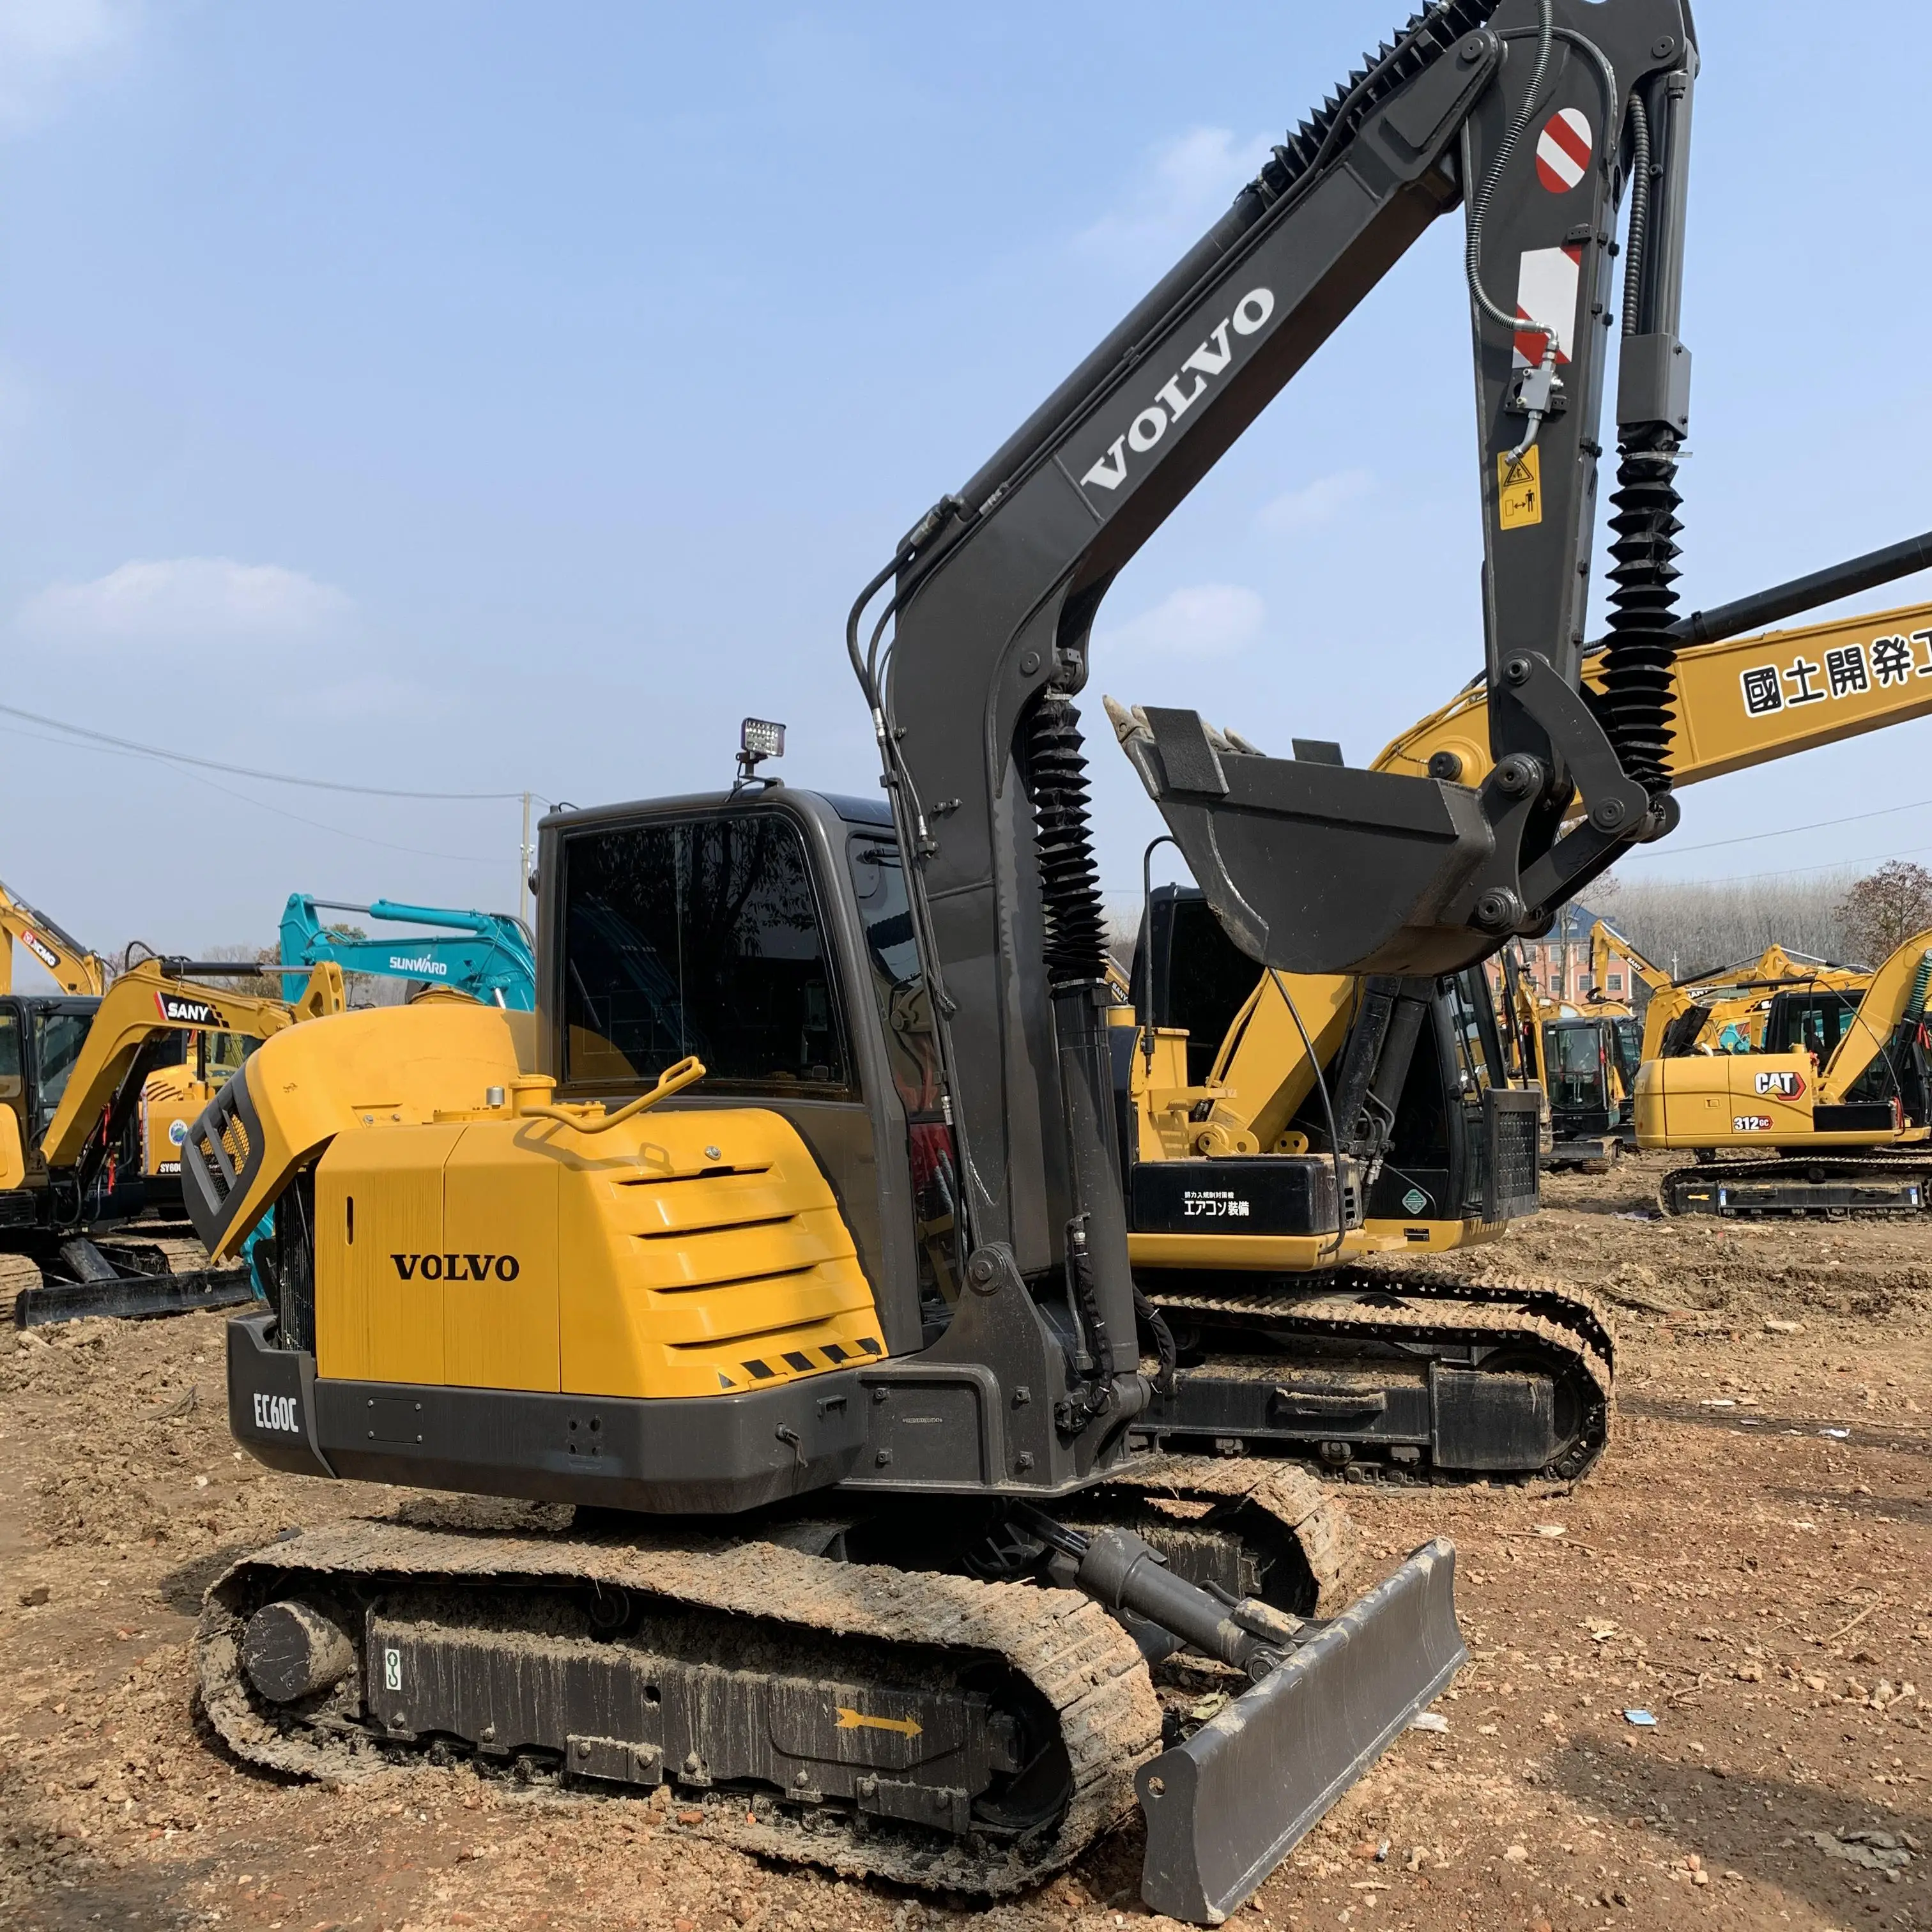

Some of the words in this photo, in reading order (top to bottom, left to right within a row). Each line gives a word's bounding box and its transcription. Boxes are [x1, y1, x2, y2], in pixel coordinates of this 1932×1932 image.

[1080, 287, 1275, 491] VOLVO
[389, 954, 447, 976] SUNWARD
[1627, 957, 1643, 970] SANY
[1112, 982, 1128, 1002] SANY
[167, 1002, 209, 1022] SANY
[1755, 1073, 1793, 1094] CAT
[1733, 1116, 1759, 1130] 312
[1759, 1119, 1770, 1127] GC
[390, 1254, 519, 1282] VOLVO
[254, 1393, 299, 1432] EC60C
